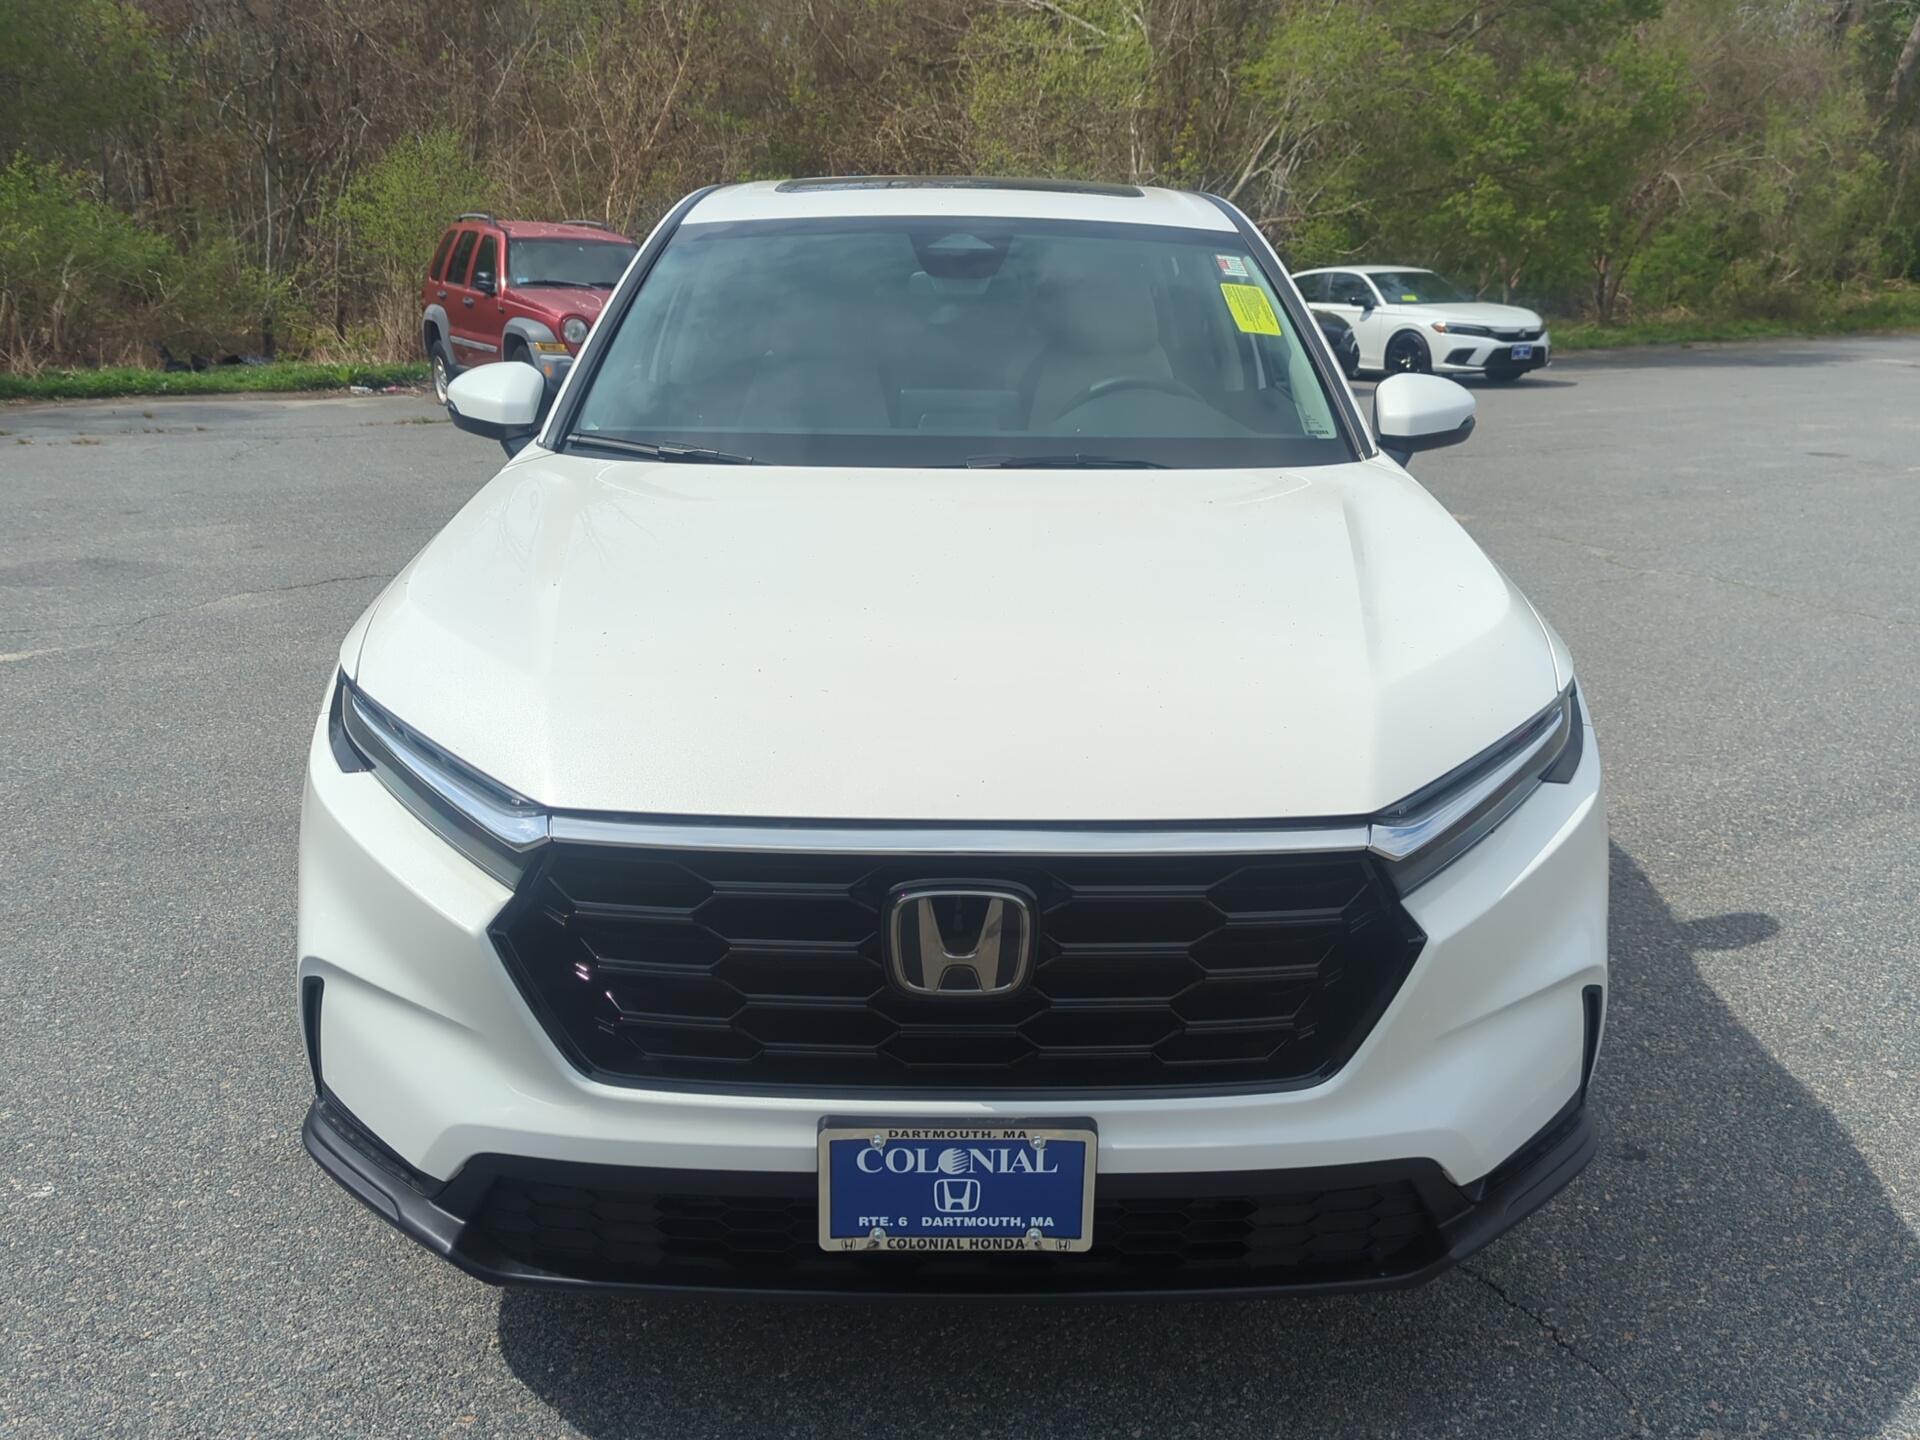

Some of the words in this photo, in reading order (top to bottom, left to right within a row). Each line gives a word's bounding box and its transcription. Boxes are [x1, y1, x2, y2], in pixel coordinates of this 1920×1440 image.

[888, 1129, 998, 1139] DARTMOUTH,
[1002, 1130, 1028, 1139] MA
[856, 1147, 1059, 1175] COLONIAL
[858, 1216, 894, 1227] RTE.
[898, 1216, 908, 1227] 6
[921, 1216, 1026, 1229] DARTMOUTH,
[1030, 1216, 1055, 1227] MA
[886, 1238, 964, 1250] COLONIAL
[969, 1238, 1025, 1250] HONDA
